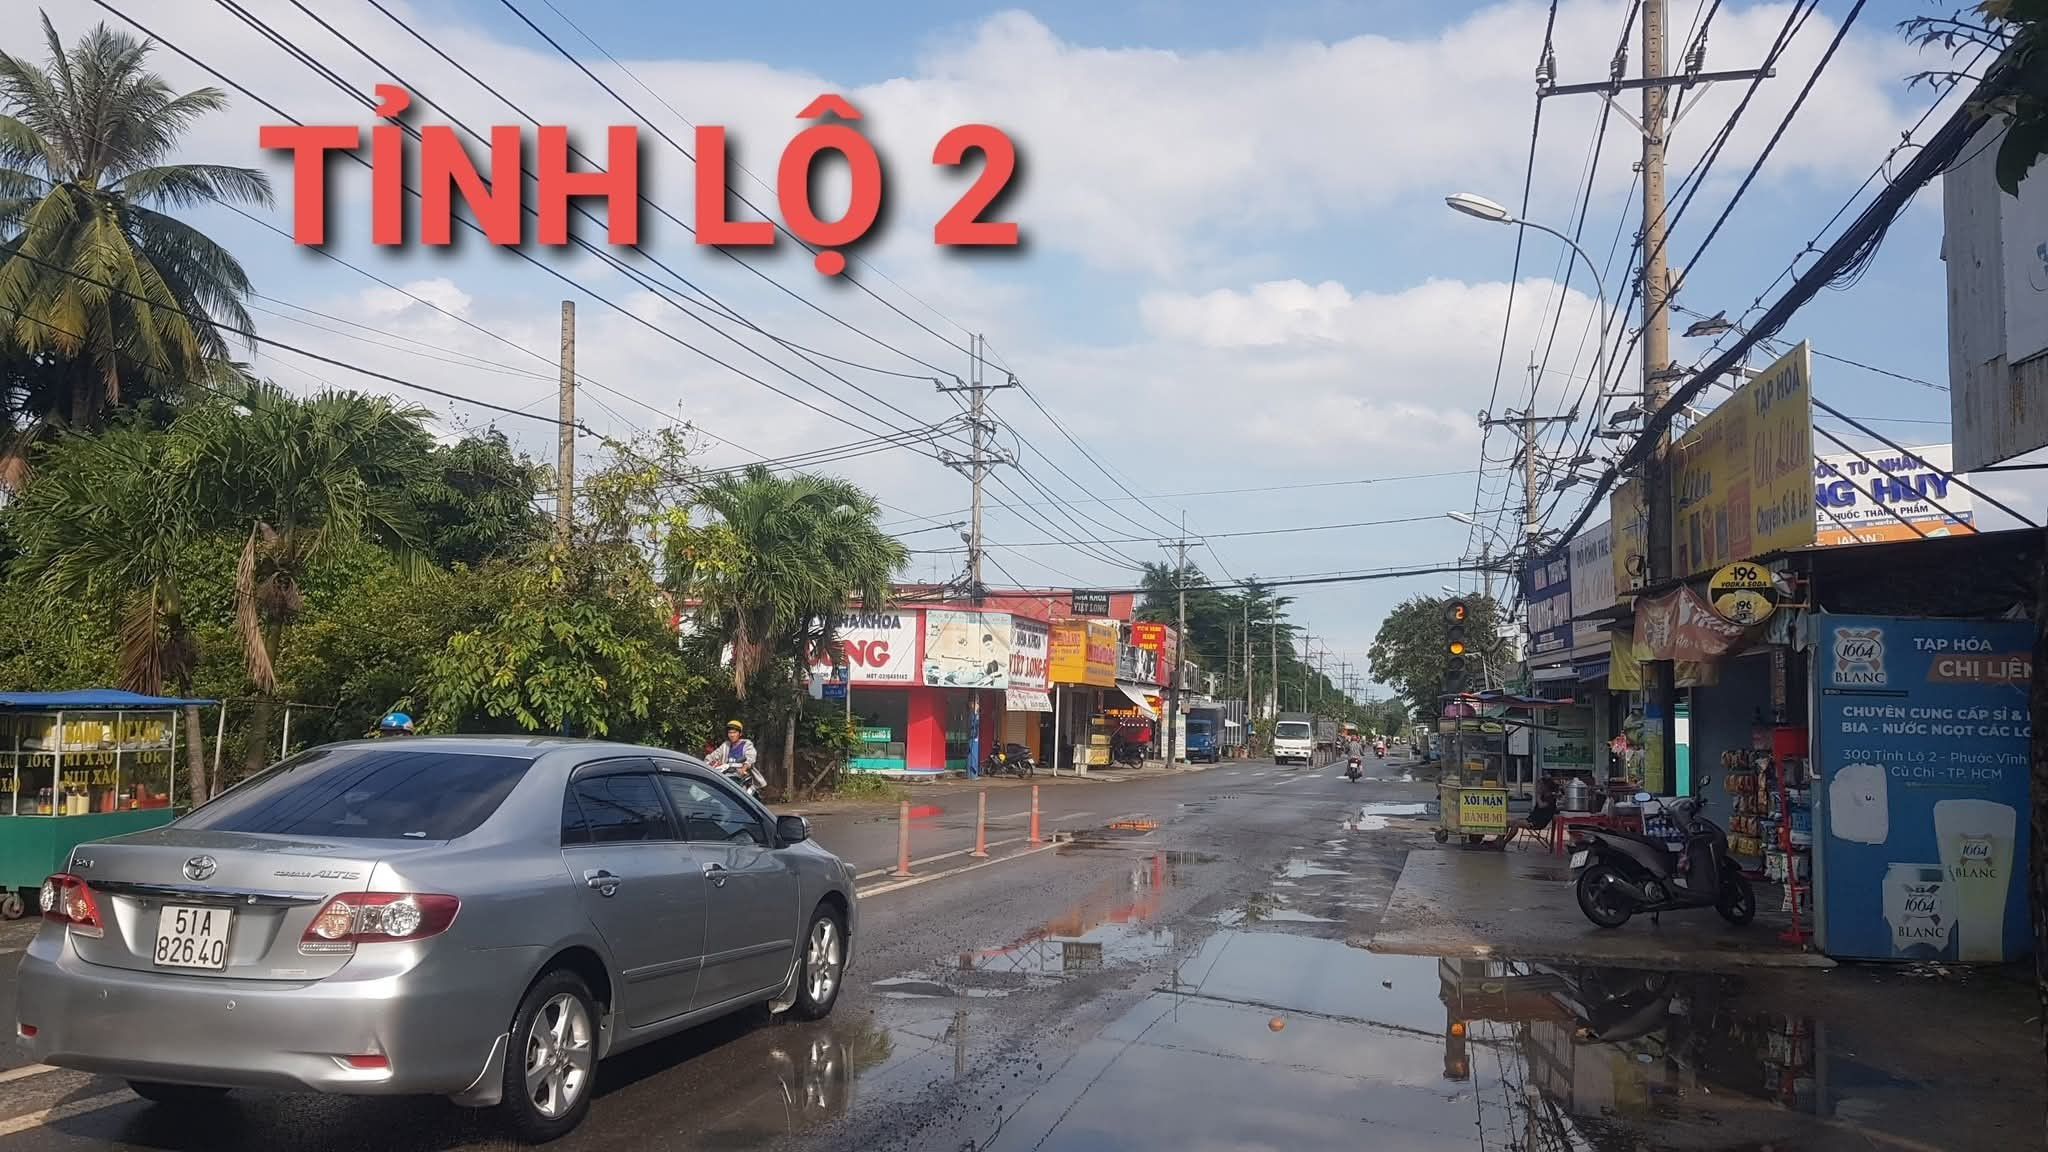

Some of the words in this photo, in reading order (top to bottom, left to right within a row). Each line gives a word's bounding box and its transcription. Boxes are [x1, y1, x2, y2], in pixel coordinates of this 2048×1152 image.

[1754, 378, 1774, 418] TẠP
[1870, 471, 1952, 505] HUY
[1842, 642, 1875, 658] 1664
[1912, 637, 1949, 654] TẠP
[1953, 635, 1993, 651] HÓA
[1835, 671, 1885, 683] BLANC
[1938, 660, 1980, 681] CHỊ
[1842, 704, 1906, 719] CHUYÊN
[1910, 707, 1953, 720] CUNG
[1957, 704, 1989, 721] CẤP
[1993, 705, 2008, 721] SỈ
[2011, 710, 2022, 721] &
[1841, 721, 1868, 734] BIA
[1882, 720, 1928, 736] NƯỚC
[1931, 723, 1974, 739] NGỌT
[1978, 722, 2010, 737] CÁC
[1842, 748, 1871, 761] 300
[1875, 747, 1904, 762] Tỉnh
[1928, 751, 1937, 762] 2
[1950, 750, 1993, 764] Phước
[1996, 750, 2027, 766] Vĩnh
[1913, 765, 1935, 778] Chi
[1971, 767, 2003, 780] HCM
[1955, 868, 1999, 879] BLANC
[1904, 897, 1936, 913] 1664
[175, 909, 212, 938] 51A
[1897, 926, 1945, 938] BLANC
[157, 935, 223, 968] 826.40
